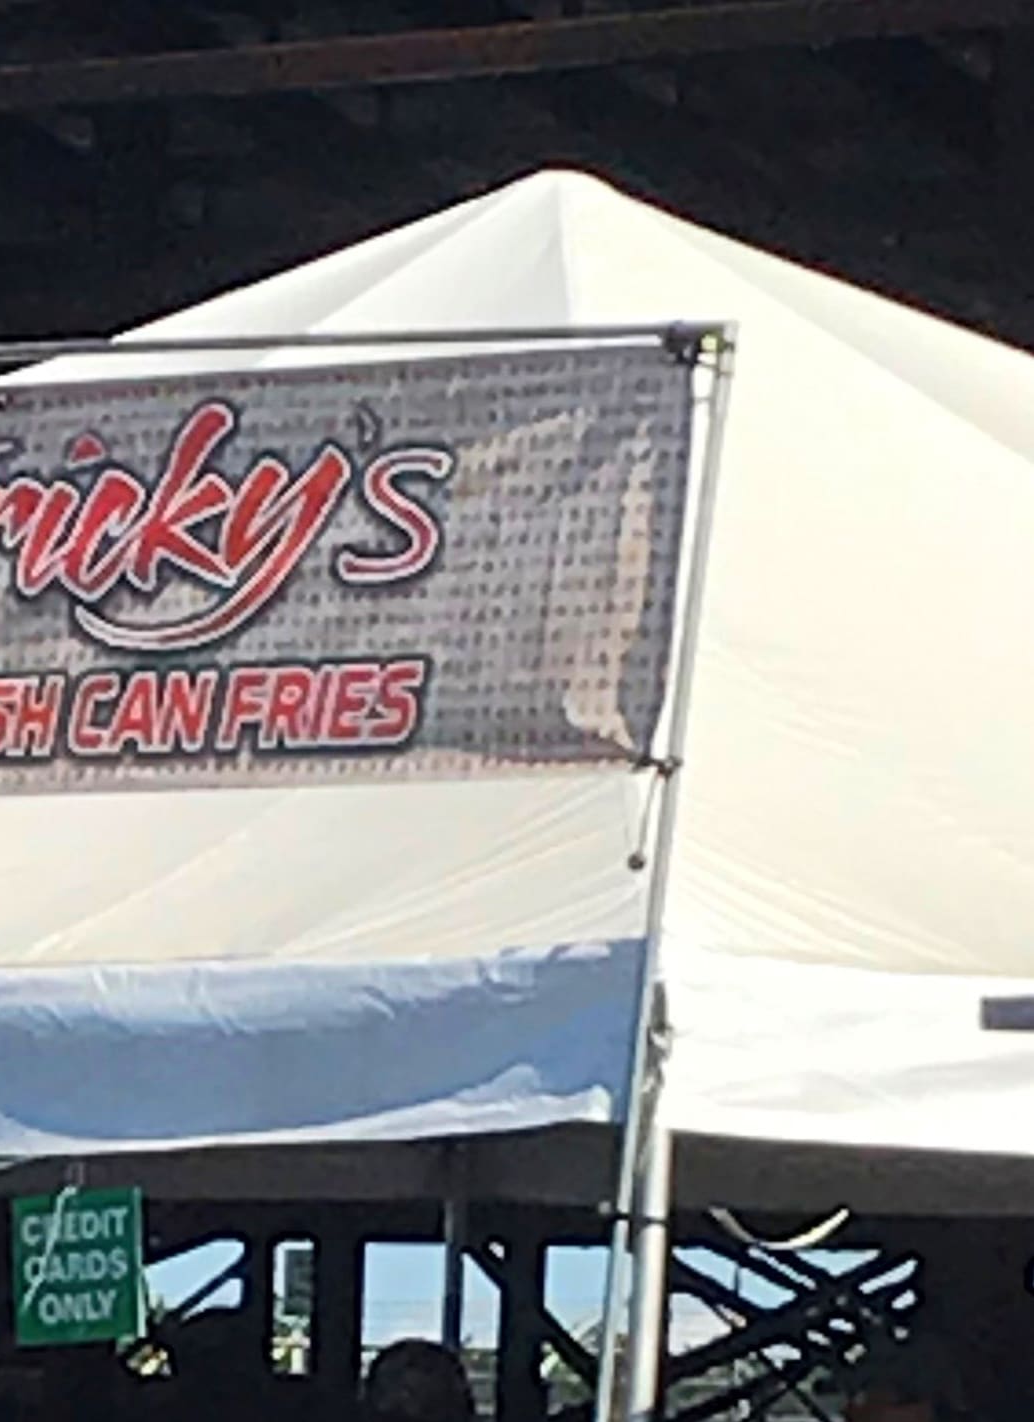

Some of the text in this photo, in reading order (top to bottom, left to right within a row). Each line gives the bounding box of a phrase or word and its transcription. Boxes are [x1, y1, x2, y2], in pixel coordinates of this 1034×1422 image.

[68, 668, 217, 754] CAN
[218, 659, 425, 750] FRIES
[23, 1246, 129, 1284] CARDS
[38, 1289, 117, 1325] ONLY
